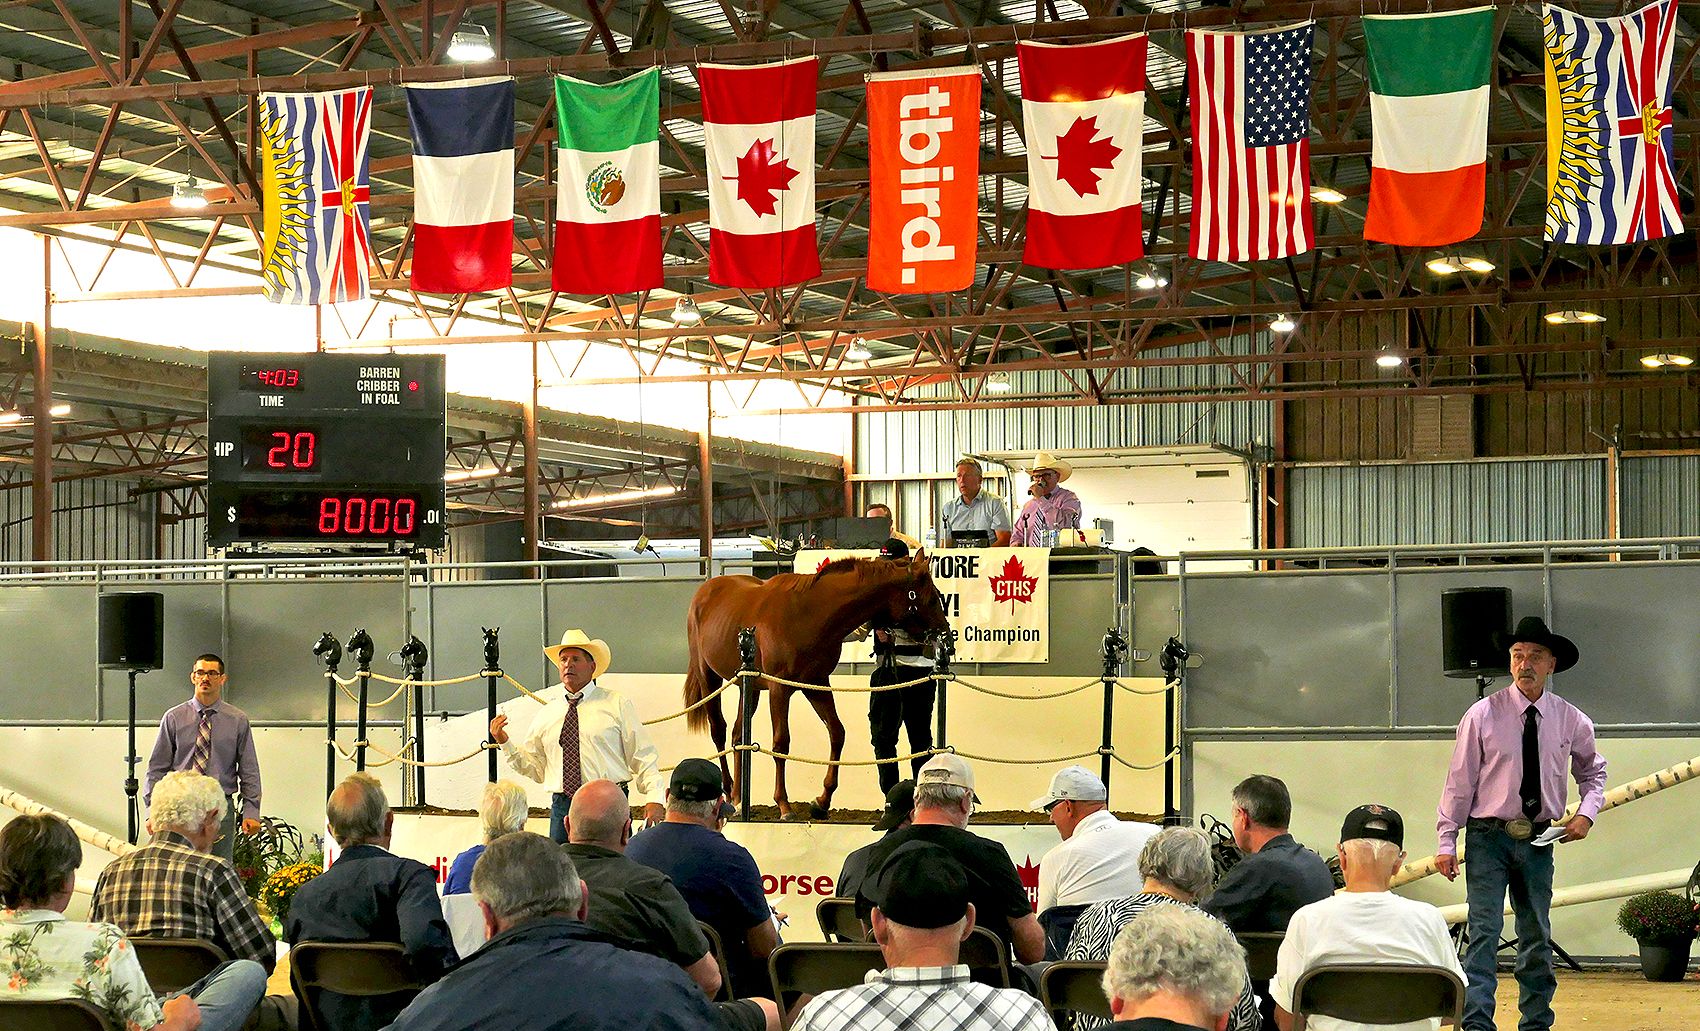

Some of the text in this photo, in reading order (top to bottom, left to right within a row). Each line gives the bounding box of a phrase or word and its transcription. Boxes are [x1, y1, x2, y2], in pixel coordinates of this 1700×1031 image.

[900, 86, 955, 285] tbird.
[359, 367, 400, 379] BARREN
[356, 380, 400, 392] CRIBBER
[259, 395, 284, 407] TIME
[361, 393, 400, 405] IN FOAL
[267, 432, 316, 468] 20
[318, 497, 415, 534] 8000
[996, 580, 1031, 597] CTHS
[964, 625, 1040, 646] Champion
[760, 874, 834, 896] orse
